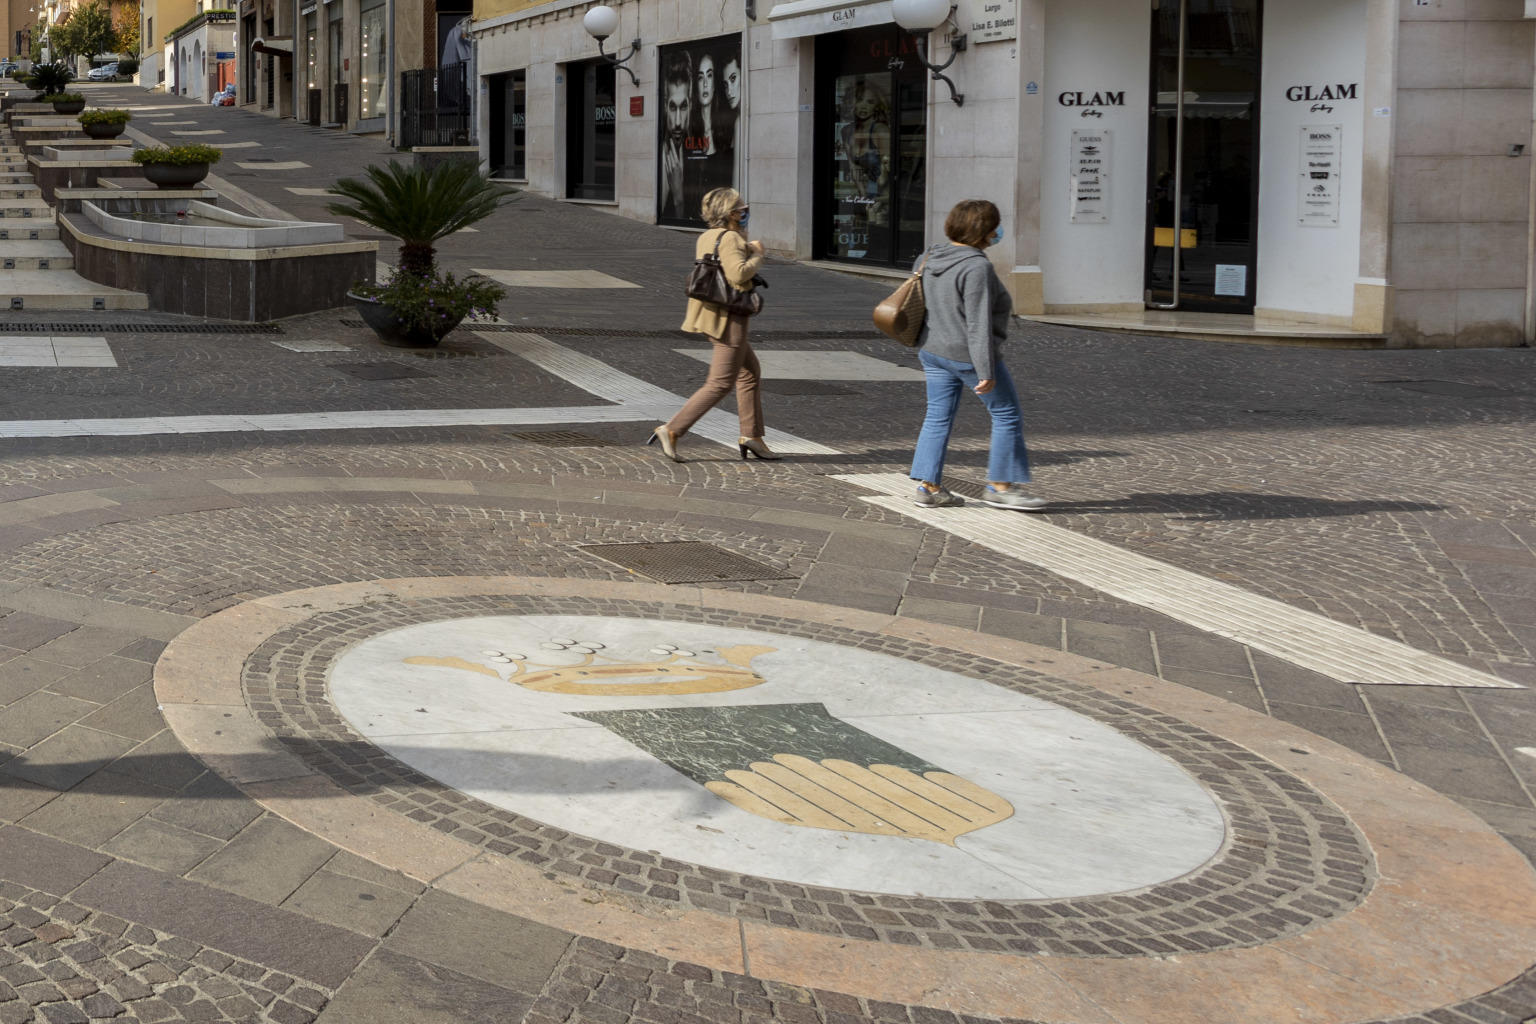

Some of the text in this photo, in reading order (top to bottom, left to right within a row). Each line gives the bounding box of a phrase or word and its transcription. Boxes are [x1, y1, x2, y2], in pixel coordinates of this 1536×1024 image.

[832, 9, 856, 22] GLAM
[984, 4, 1001, 13] Largo
[972, 17, 1015, 31] Lisa E. Bilotti
[1058, 91, 1126, 107] GLAM
[1286, 83, 1359, 102] GLAM
[595, 105, 616, 121] BOSS
